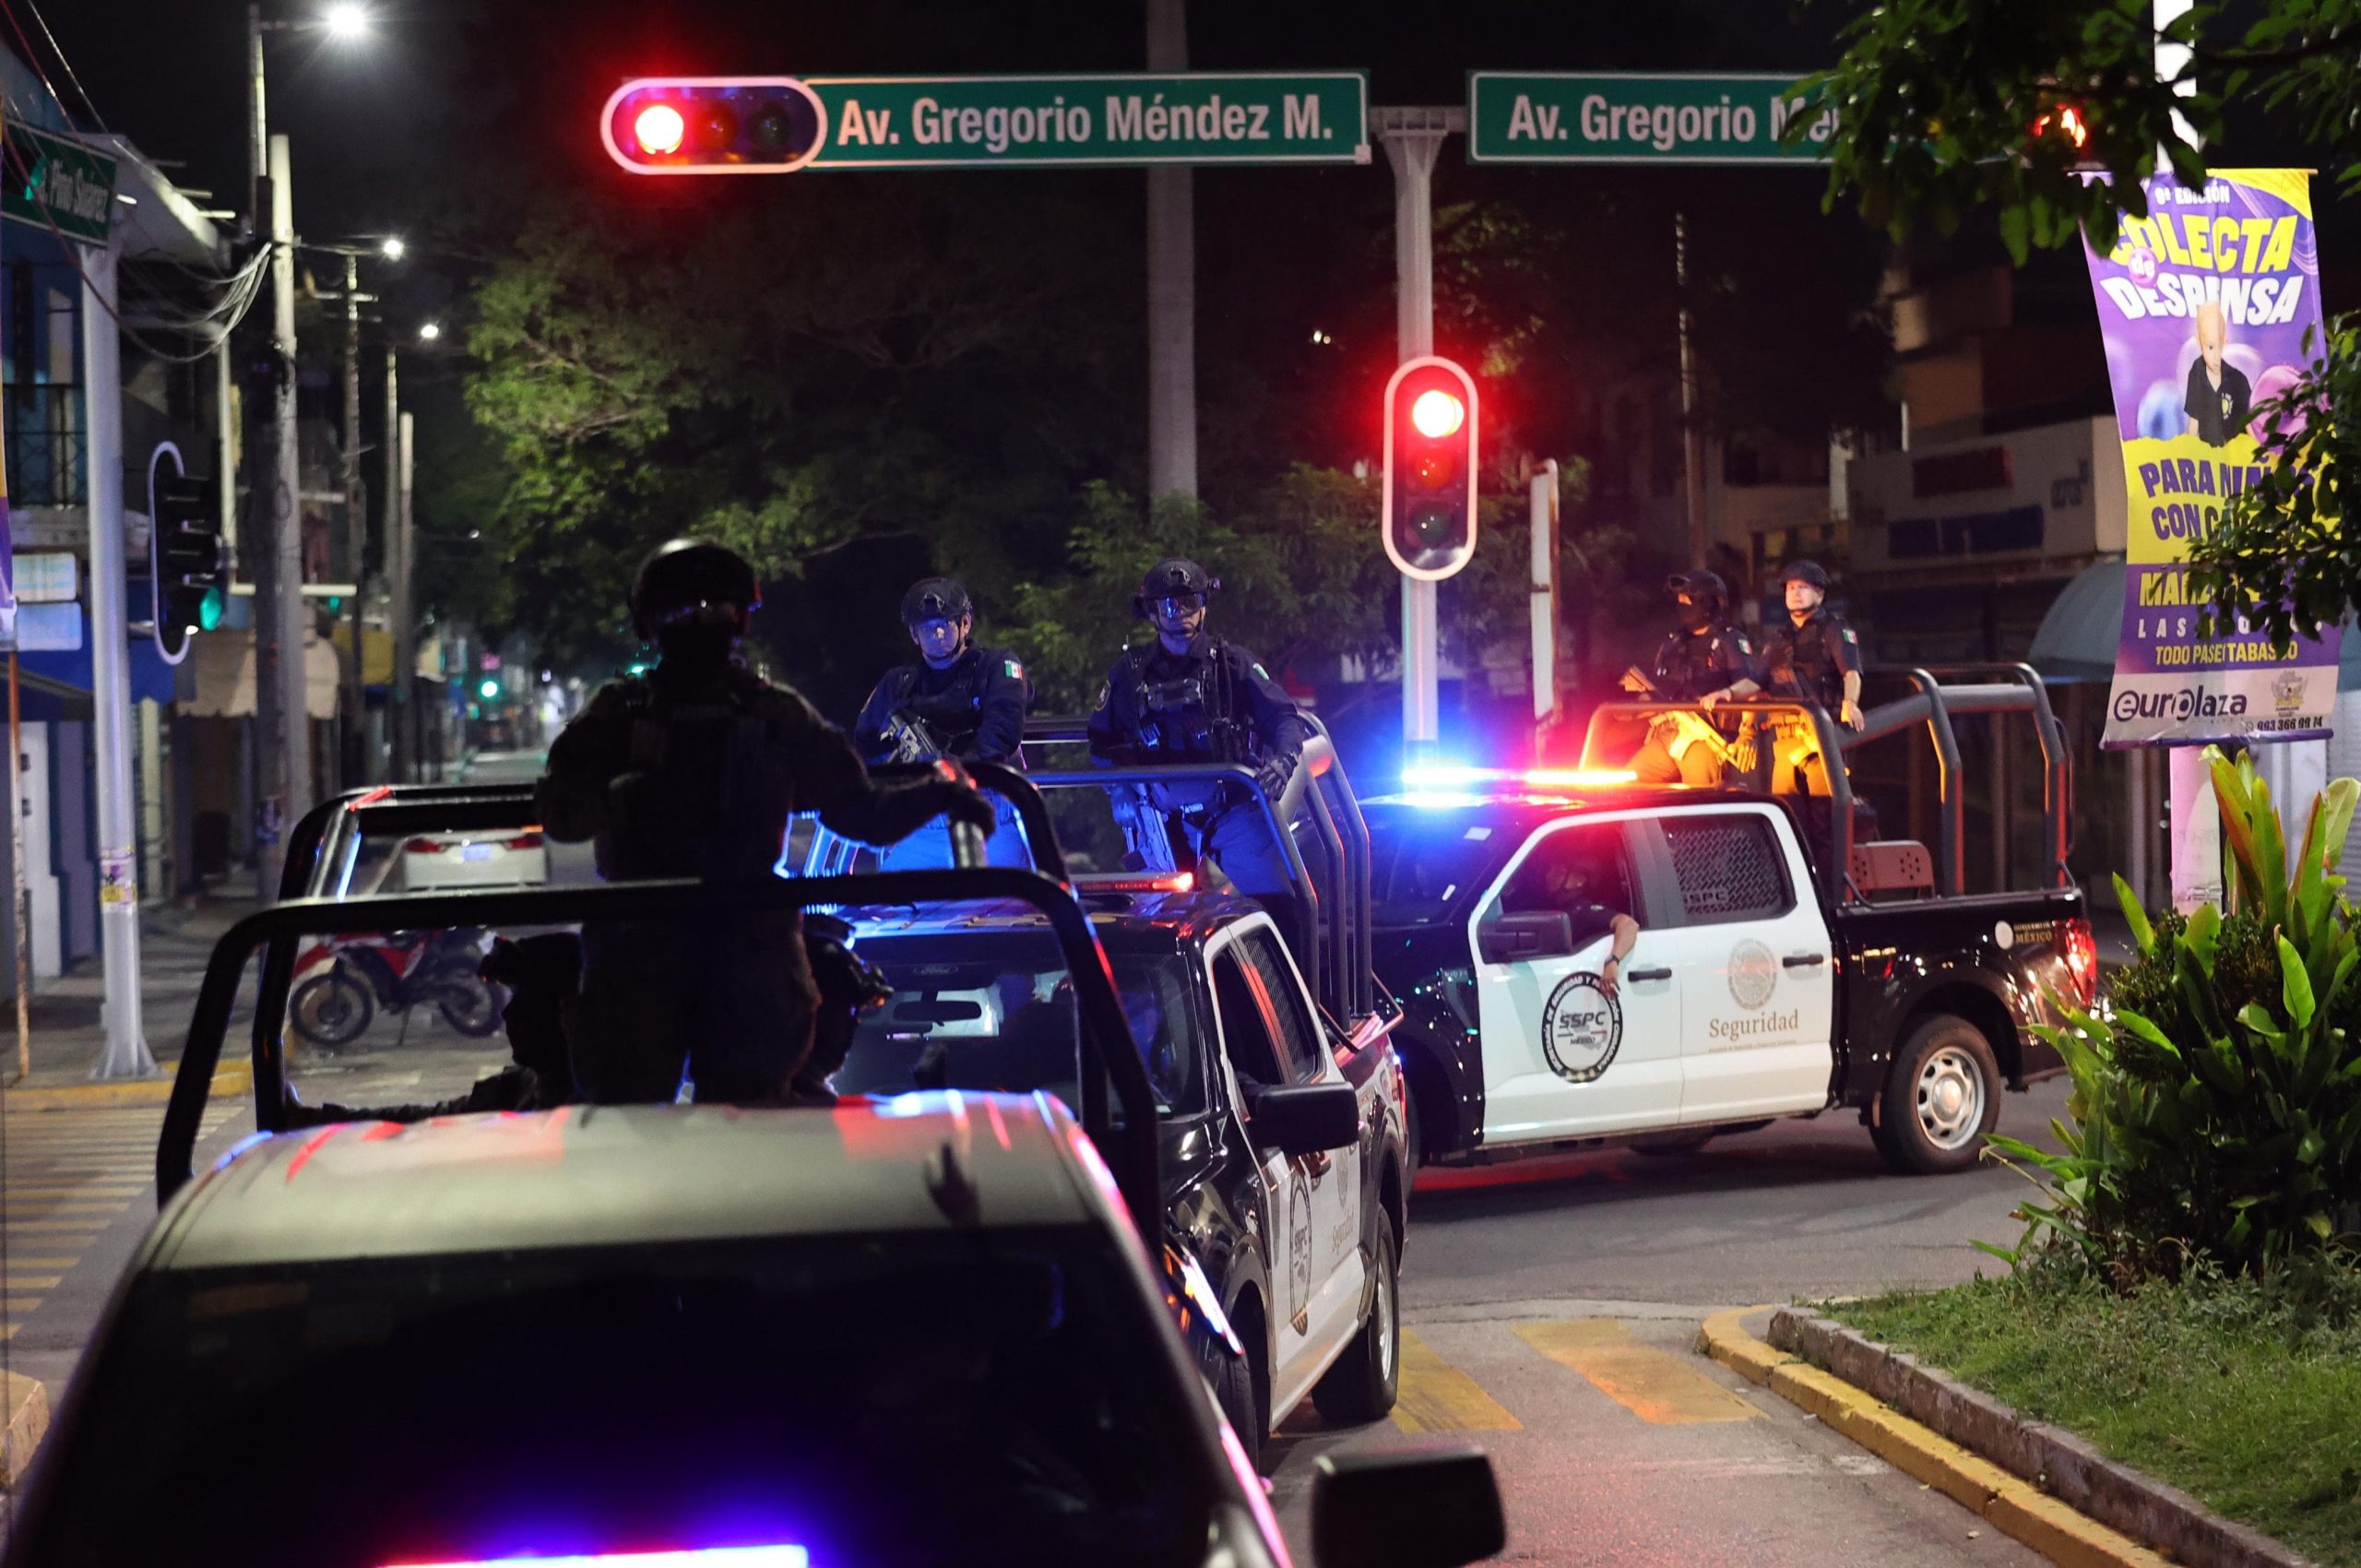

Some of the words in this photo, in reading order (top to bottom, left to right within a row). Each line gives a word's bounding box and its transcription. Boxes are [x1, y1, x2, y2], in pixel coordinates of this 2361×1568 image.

[837, 99, 899, 147] Av.
[911, 97, 1091, 153] Gregorio
[1106, 94, 1269, 141] Méndez
[1284, 94, 1332, 139] M.
[1508, 94, 1568, 140] Av.
[1581, 94, 1756, 151] Gregorio
[2130, 253, 2155, 279] de
[2139, 458, 2216, 498] PARA
[2151, 504, 2201, 540] CON
[2138, 617, 2187, 638] LAS
[2155, 646, 2190, 665] TODO
[2226, 641, 2298, 663] TABASO
[2015, 932, 2052, 944] MÉXICO
[1559, 1011, 1607, 1029] SSPC
[1709, 1008, 1798, 1041] Seguridad
